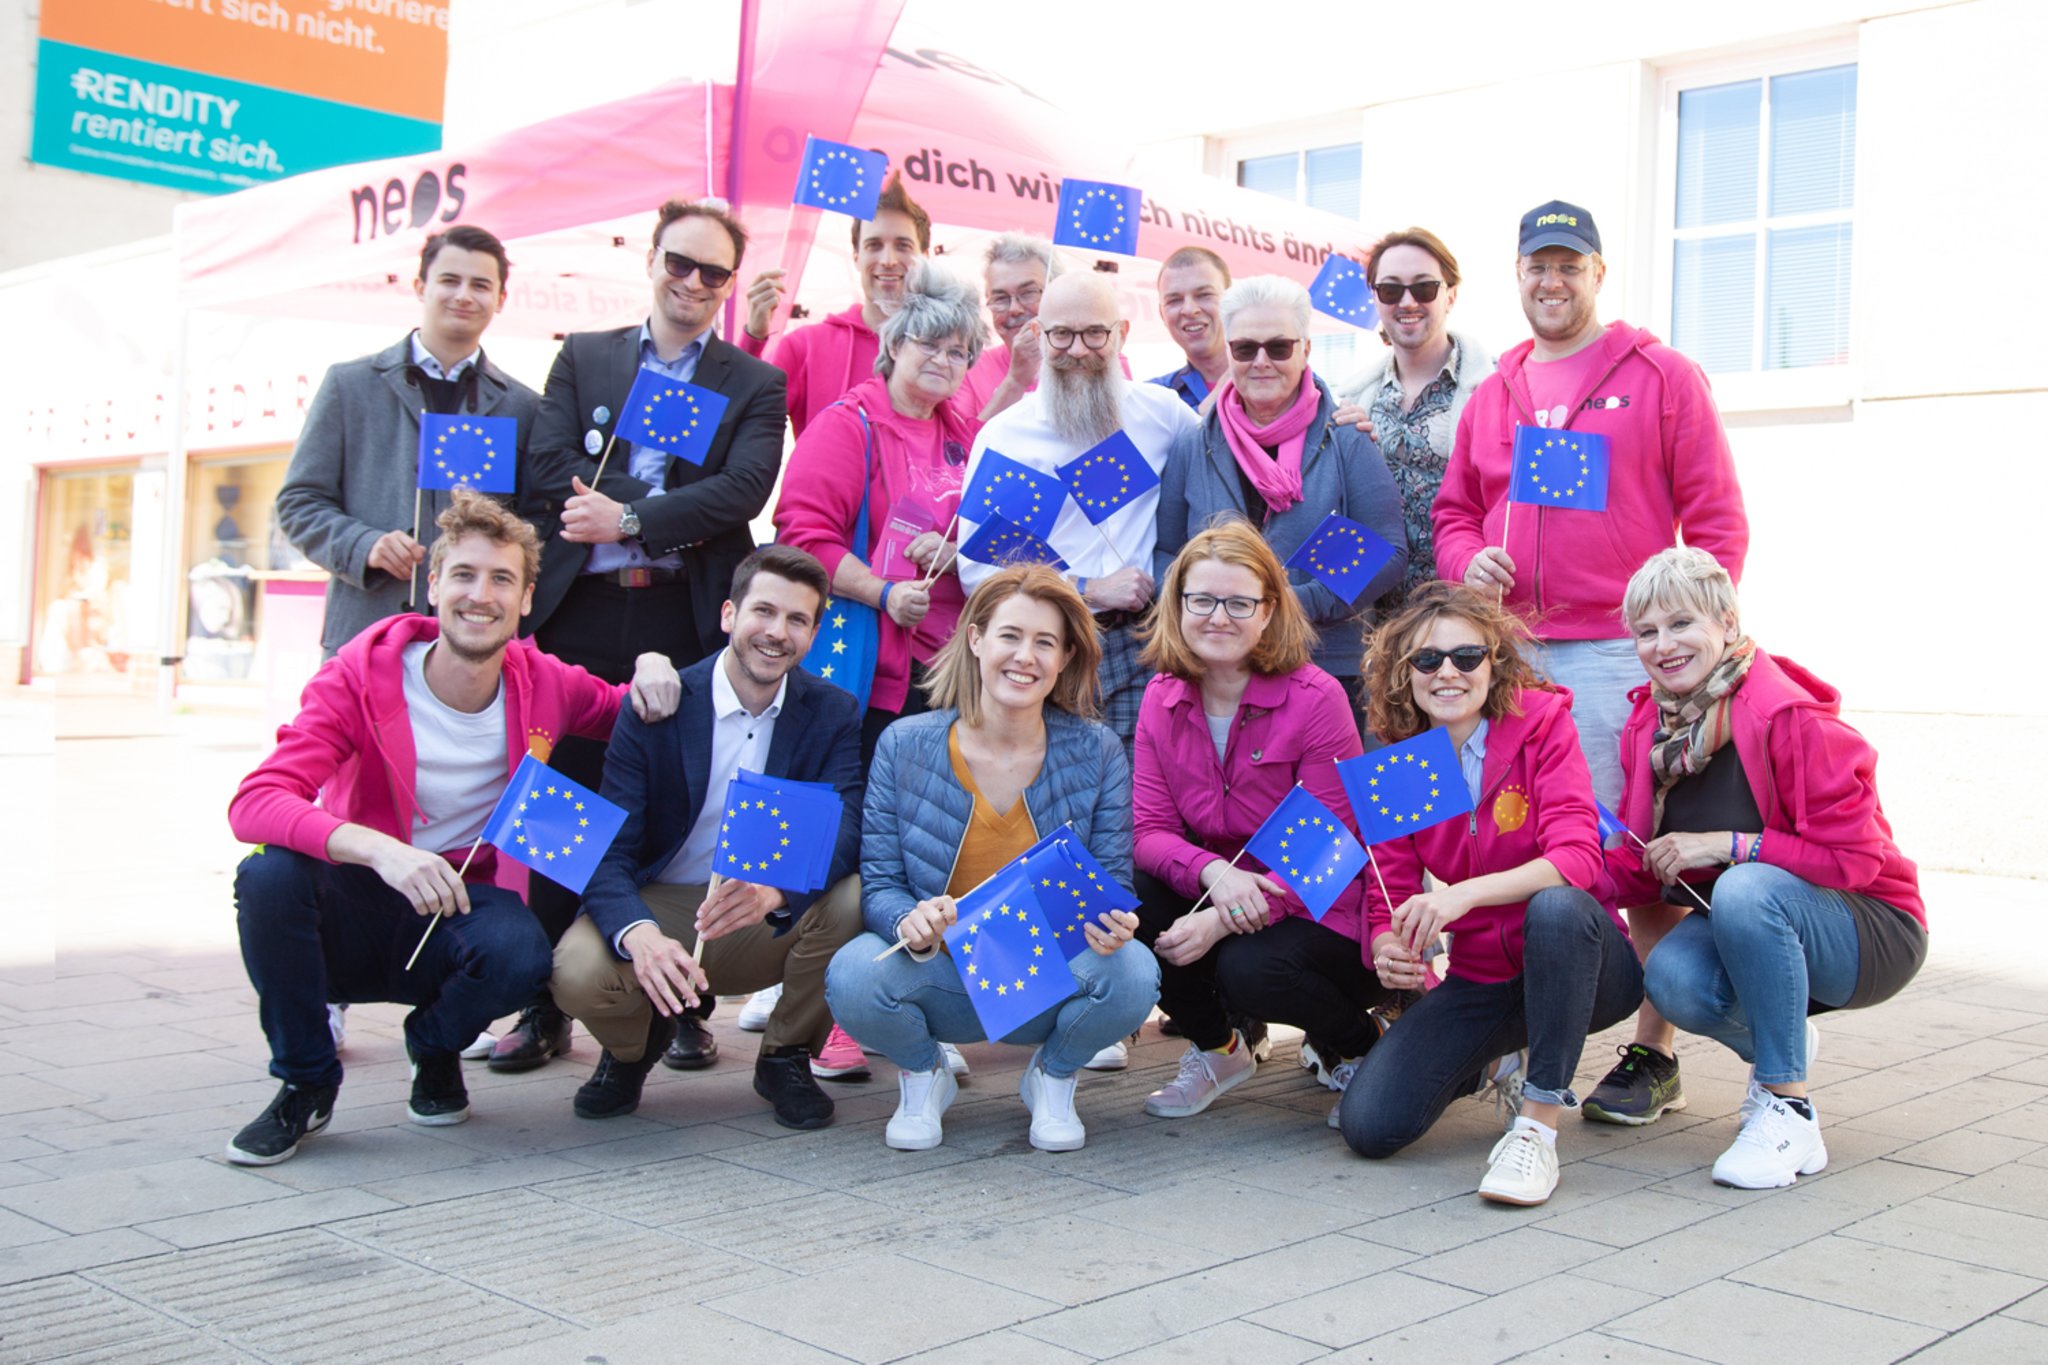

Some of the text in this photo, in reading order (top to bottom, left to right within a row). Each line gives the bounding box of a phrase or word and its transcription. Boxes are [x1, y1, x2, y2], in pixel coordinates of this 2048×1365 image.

[297, 10, 385, 54] nicht.
[70, 67, 240, 129] RENDITY
[71, 111, 204, 157] rentiert
[208, 134, 284, 172] sich.
[904, 147, 996, 193] dich
[1182, 208, 1276, 253] nichts
[1536, 213, 1577, 227] neos
[1580, 395, 1630, 410] neos
